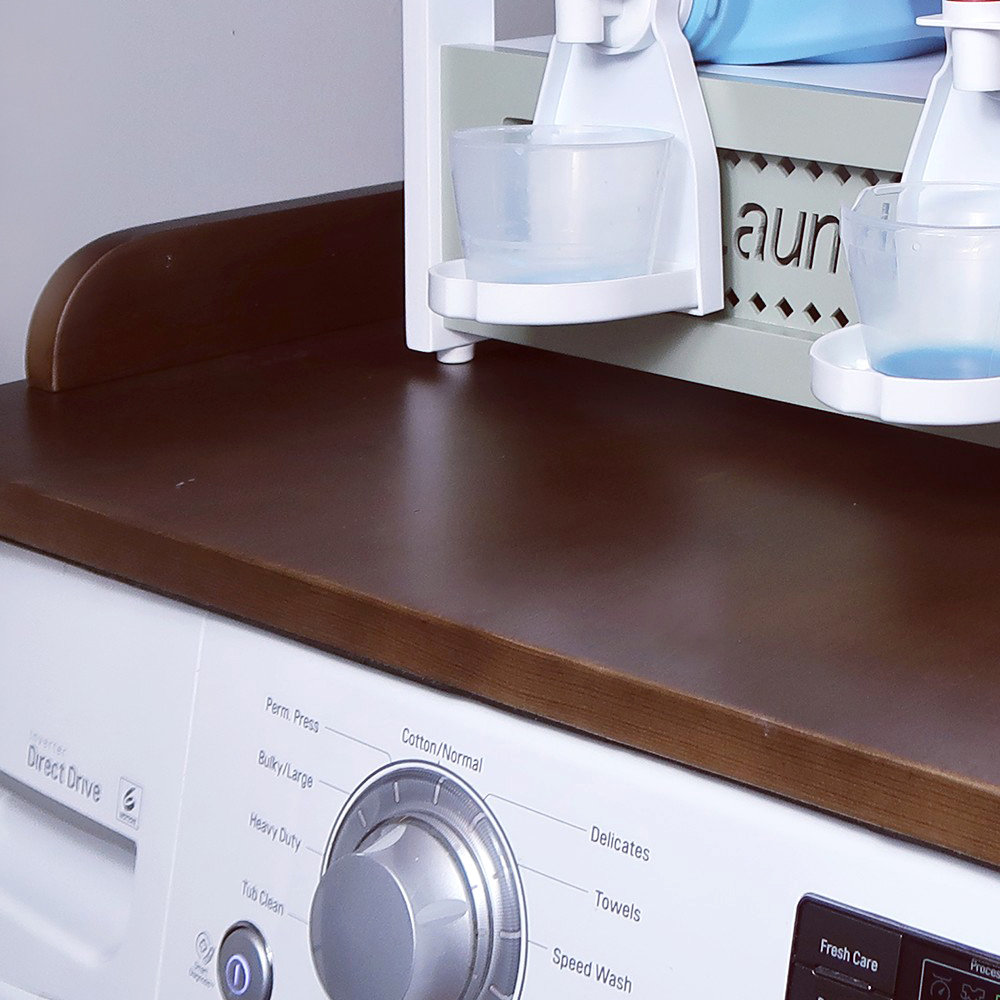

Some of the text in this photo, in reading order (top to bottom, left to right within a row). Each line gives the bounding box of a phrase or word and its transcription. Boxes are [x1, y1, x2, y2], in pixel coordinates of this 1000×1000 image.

[265, 696, 319, 734] Perm. Press
[258, 749, 314, 789] Bulky/Large
[401, 727, 484, 773] Cotton/Normal
[27, 744, 101, 803] Direct Drive
[249, 811, 302, 854] Heavy Duty
[590, 825, 651, 862] Delicates
[241, 880, 284, 916] Tub Clean
[594, 890, 642, 922] Towels
[552, 947, 633, 994] Speed Wash
[820, 938, 879, 972] Fresh Care
